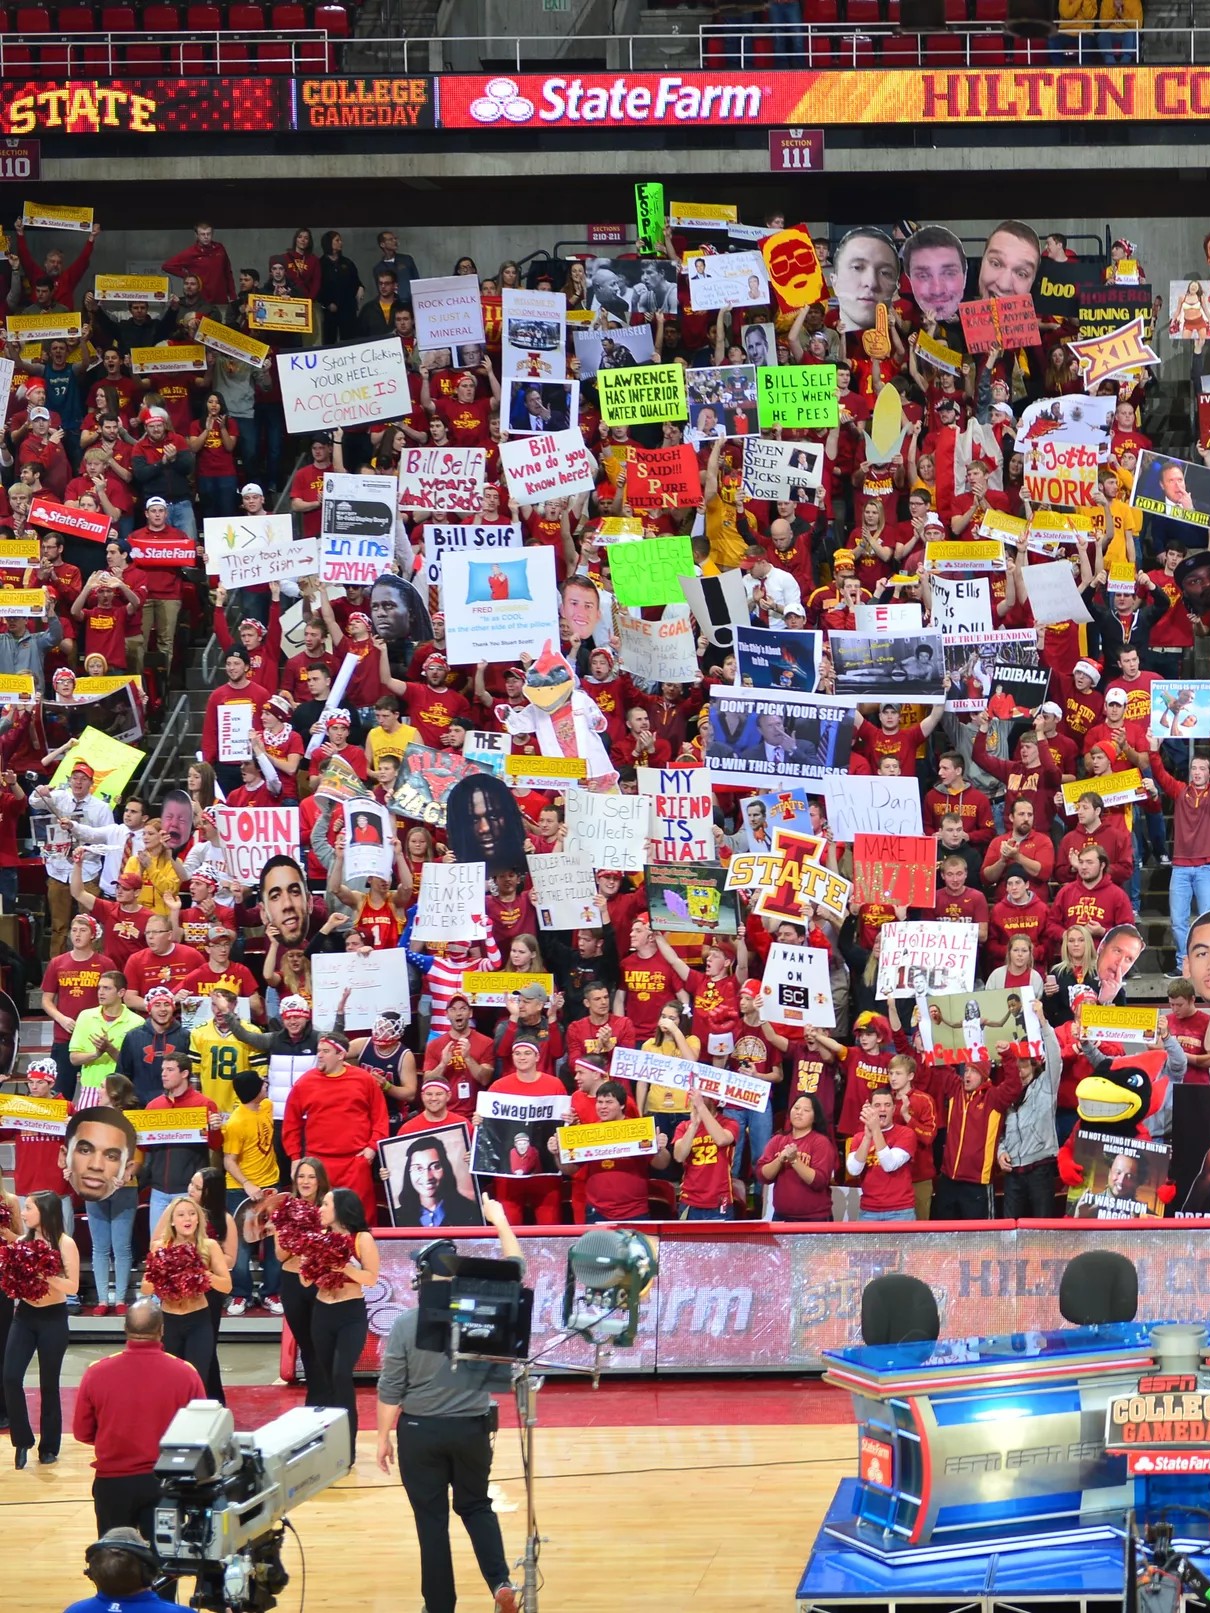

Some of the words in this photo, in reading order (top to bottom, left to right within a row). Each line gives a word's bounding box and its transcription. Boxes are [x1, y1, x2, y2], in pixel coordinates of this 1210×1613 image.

[302, 79, 426, 104] COLLEGE
[922, 73, 1135, 117] HILTON
[10, 88, 156, 132] STATE
[310, 103, 419, 127] GAMEDAY
[781, 139, 812, 147] SECTION
[782, 148, 811, 167] 111
[593, 232, 621, 241] 210-211
[1040, 277, 1075, 298] boo
[418, 299, 443, 309] ROCK
[446, 295, 477, 306] CHALK
[428, 314, 436, 323] IS
[439, 313, 460, 322] JUST
[1079, 307, 1130, 321] RUINING
[1135, 307, 1153, 320] KU
[430, 326, 473, 339] MINERAL
[137, 349, 200, 360] CYCLONES
[291, 354, 317, 370] KU
[322, 353, 357, 371] Start
[360, 348, 402, 364] Clicking
[603, 370, 677, 388] LAWRENCE
[764, 371, 798, 390] BILL
[802, 370, 834, 386] SELF
[605, 390, 627, 405] HAS
[628, 385, 678, 403] INFERIOR
[768, 390, 798, 404] SITS
[803, 389, 831, 402] WHEN
[607, 405, 638, 421] WATER
[640, 403, 681, 419] QUALITY
[772, 410, 787, 422] HE
[797, 408, 829, 421] PEES
[1025, 475, 1099, 506] WORK
[1135, 498, 1165, 513] GOLD
[994, 665, 1047, 684] HOIBALL
[720, 700, 753, 713] DON'T
[756, 702, 783, 715] PICK
[786, 705, 816, 718] YOUR
[818, 708, 846, 722] SELF
[510, 759, 586, 774] CYCLONES
[705, 756, 718, 769] TO
[721, 757, 745, 770] WIN
[749, 759, 776, 773] THIS
[777, 761, 803, 774] ONE
[805, 763, 848, 777] KANSAS
[218, 810, 294, 844] JOHN
[729, 856, 849, 911] STATE
[624, 971, 648, 982] LIVE
[1082, 1009, 1153, 1025] CYCLONES
[209, 1045, 238, 1079] 18
[614, 1063, 666, 1084] BEWARE
[698, 1077, 721, 1093] THE
[1085, 1193, 1094, 1204] IT
[1094, 1195, 1116, 1208] WAS
[1116, 1198, 1148, 1214] HILTON
[1139, 1375, 1196, 1393] ESPN
